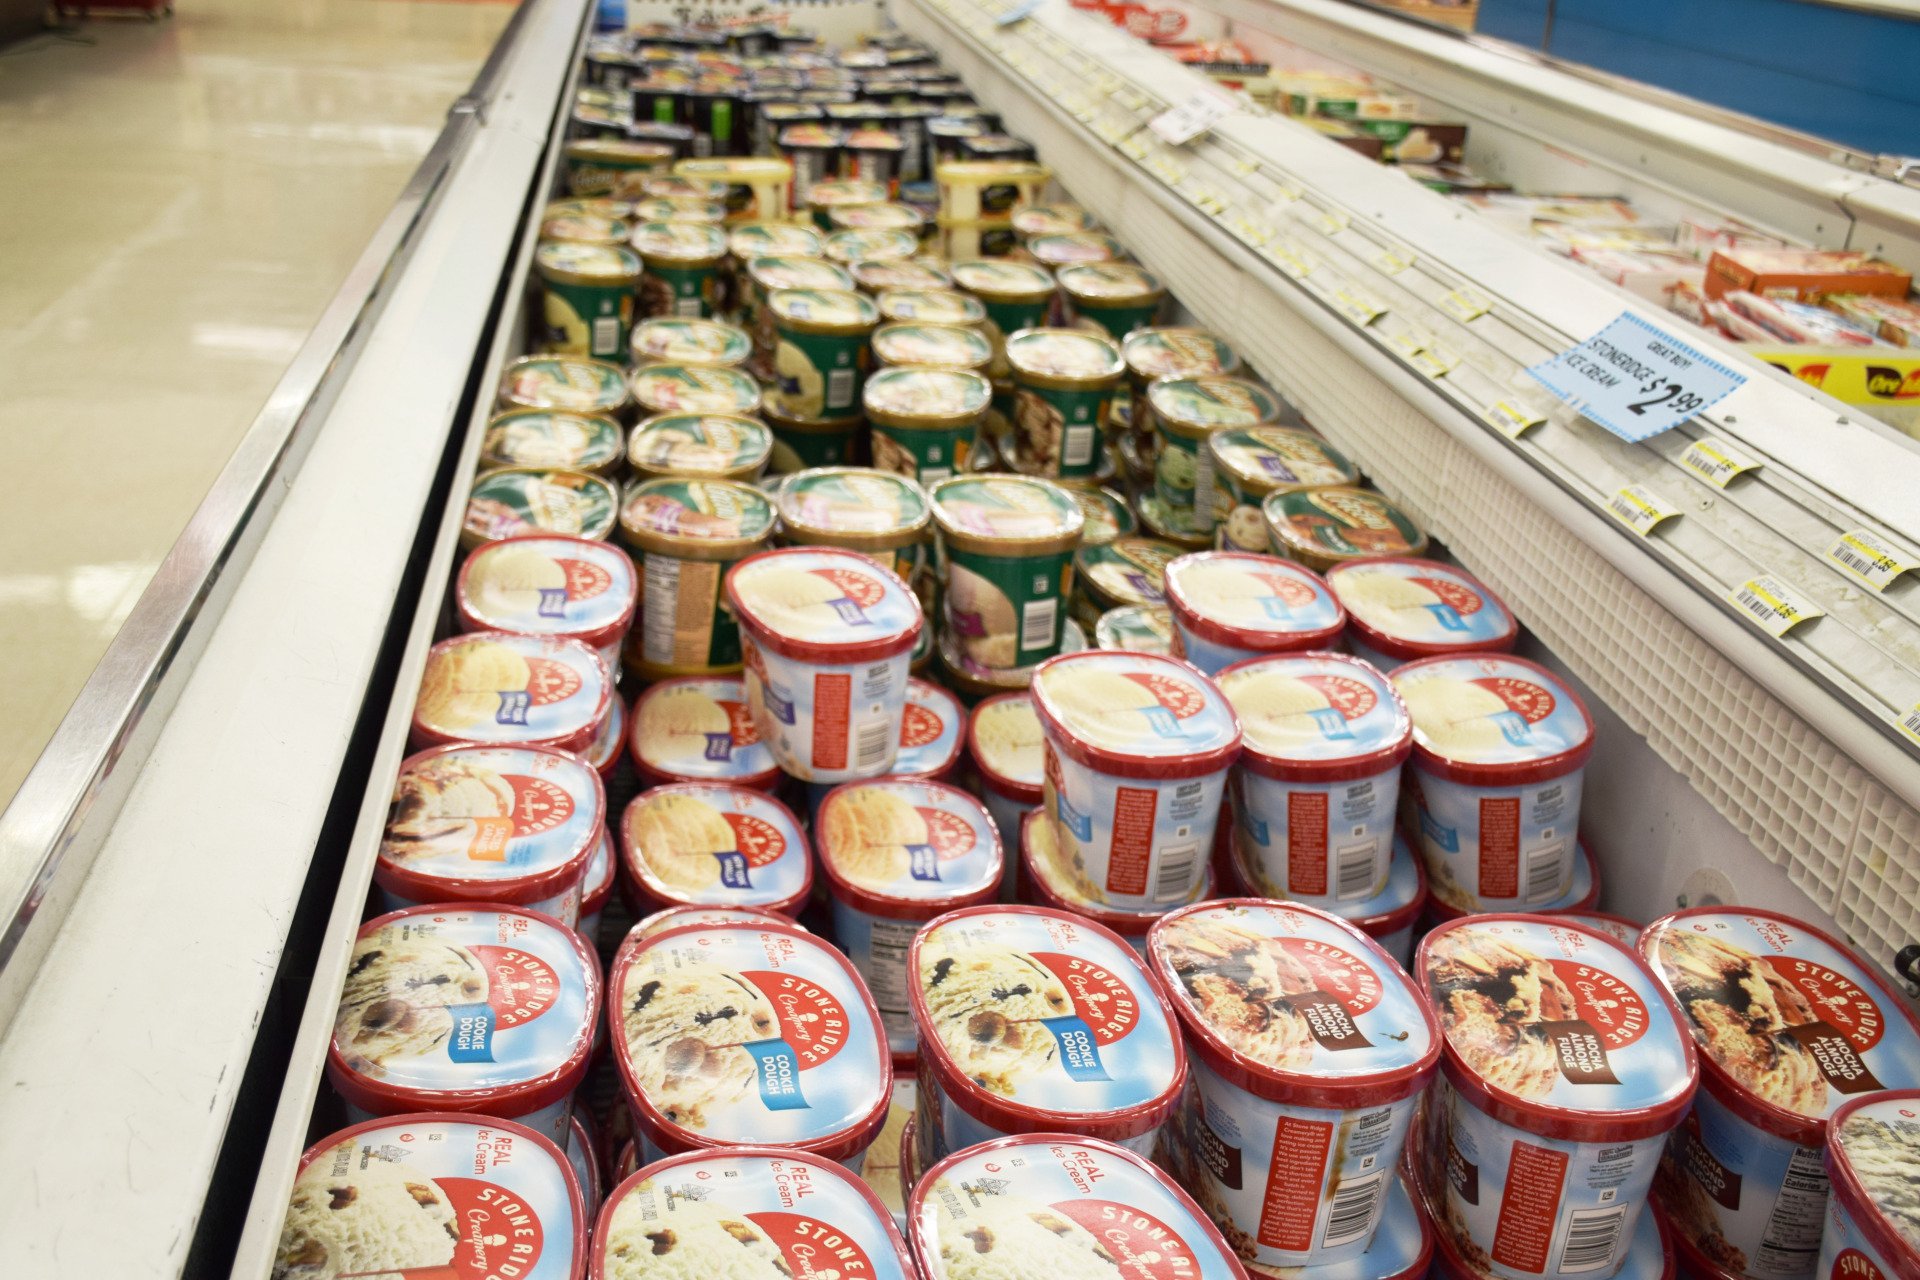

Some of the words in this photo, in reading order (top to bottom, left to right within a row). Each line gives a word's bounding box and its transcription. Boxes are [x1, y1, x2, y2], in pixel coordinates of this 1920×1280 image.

[1587, 339, 1656, 382] STONERIDGE
[1647, 340, 1671, 358] GREAT
[1567, 353, 1587, 369] ICE
[1579, 363, 1622, 388] CREAM
[531, 781, 570, 808] STONE
[520, 809, 568, 835] RIDGE
[777, 938, 796, 961] REAL
[1757, 927, 1784, 953] Cream
[1763, 922, 1794, 946] REAL
[496, 965, 517, 1006] Creamery
[502, 952, 553, 986] STONE
[1304, 941, 1366, 972] STONE
[1349, 975, 1378, 1010] RIDGE
[1306, 954, 1351, 993] Creamery
[1576, 967, 1637, 1003] STONE
[502, 990, 553, 1024] RIDGE
[781, 977, 839, 1015] STONE
[1068, 974, 1106, 1021] Creamery
[1068, 960, 1127, 996] STONE
[1098, 1000, 1132, 1039] RIDGE
[1576, 981, 1613, 1026] Creamery
[1795, 961, 1862, 998] STONE
[1852, 1001, 1878, 1044] RIDGE
[1800, 977, 1853, 1026] Creamery
[458, 1018, 473, 1050] DOUGH
[472, 1016, 487, 1050] COOKIE
[778, 993, 812, 1043] Creamery
[1304, 1008, 1330, 1037] FUDGE
[1313, 1003, 1345, 1040] ALMOND
[1328, 1003, 1354, 1036] MOCHA
[1606, 1006, 1642, 1044] RIDGE
[802, 1020, 843, 1063] RIDGE
[1061, 1032, 1082, 1068] DOUGH
[1073, 1031, 1096, 1068] COOKIE
[1557, 1037, 1577, 1068] FUDGE
[1568, 1032, 1592, 1073] ALMOND
[1583, 1034, 1605, 1069] MOCHA
[1816, 1036, 1856, 1080] ALMOND
[1831, 1037, 1864, 1076] MOCHA
[762, 1056, 781, 1095] DOUGH
[776, 1054, 795, 1094] COOKIE
[1809, 1043, 1841, 1077] FUDGE
[478, 1129, 493, 1141] Ice
[493, 1137, 513, 1166] REAL
[474, 1140, 493, 1175] Cream
[770, 1160, 784, 1173] Ice
[1050, 1146, 1067, 1159] Ice
[1063, 1158, 1092, 1194] Cream
[1071, 1151, 1106, 1183] REAL
[774, 1173, 793, 1208] Cream
[790, 1166, 814, 1198] REAL
[1785, 1177, 1822, 1190] Calories
[477, 1188, 535, 1237] STONE
[1102, 1206, 1179, 1251] STONE
[467, 1208, 491, 1271] Creamery
[794, 1221, 865, 1271] STONE
[1841, 1255, 1876, 1280] STONE
